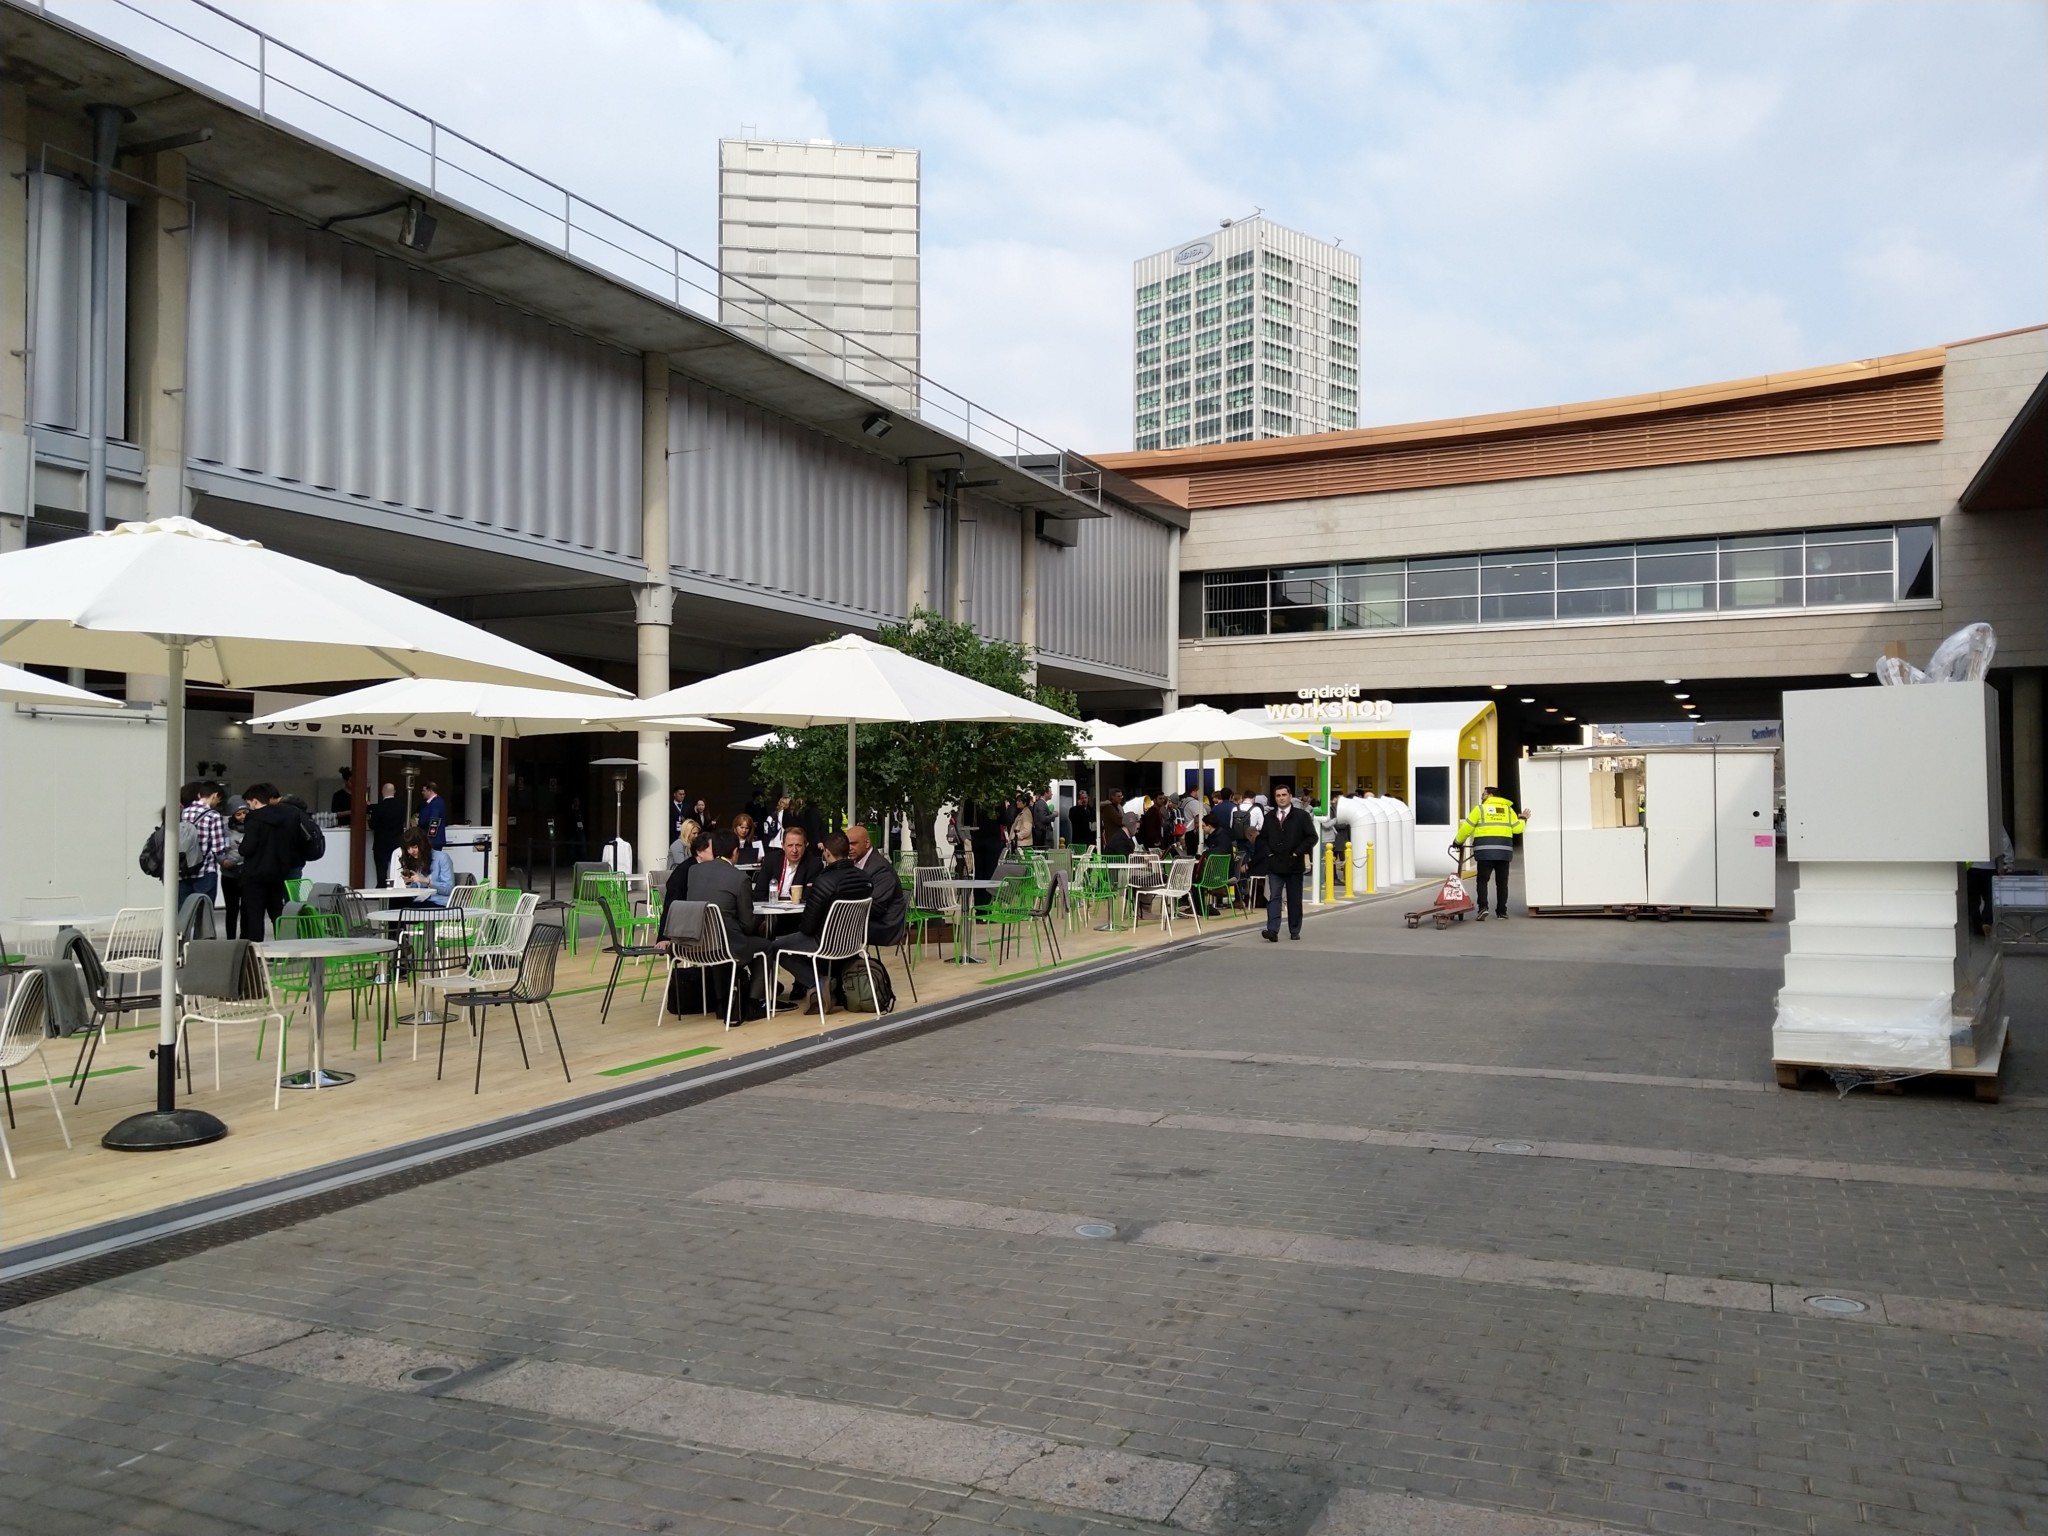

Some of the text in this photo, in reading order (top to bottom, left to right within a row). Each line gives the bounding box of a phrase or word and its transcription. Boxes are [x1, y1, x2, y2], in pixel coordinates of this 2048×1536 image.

[1298, 684, 1360, 698] android
[1265, 698, 1393, 721] workshop
[341, 724, 374, 735] BAR
